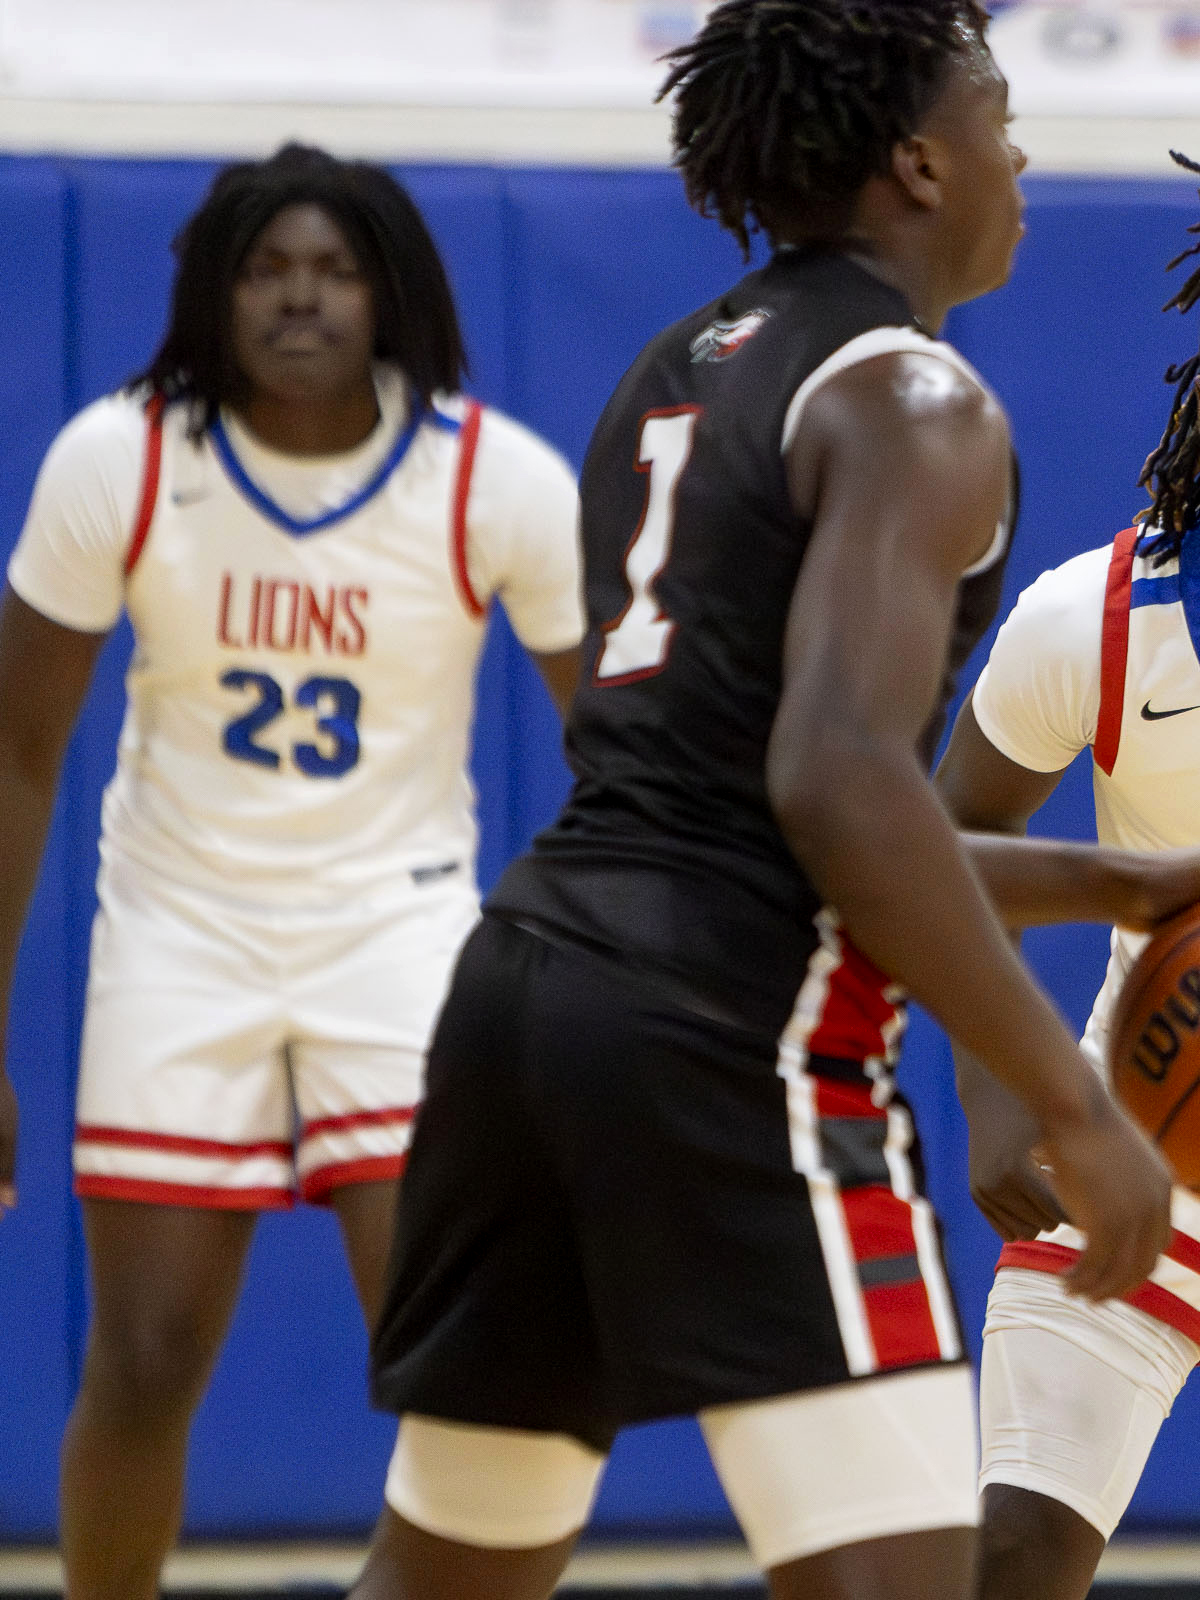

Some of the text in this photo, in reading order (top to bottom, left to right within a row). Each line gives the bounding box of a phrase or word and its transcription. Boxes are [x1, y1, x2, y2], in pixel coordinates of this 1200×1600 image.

[591, 402, 704, 688] 1
[216, 571, 369, 660] LIONS
[219, 667, 363, 780] 23
